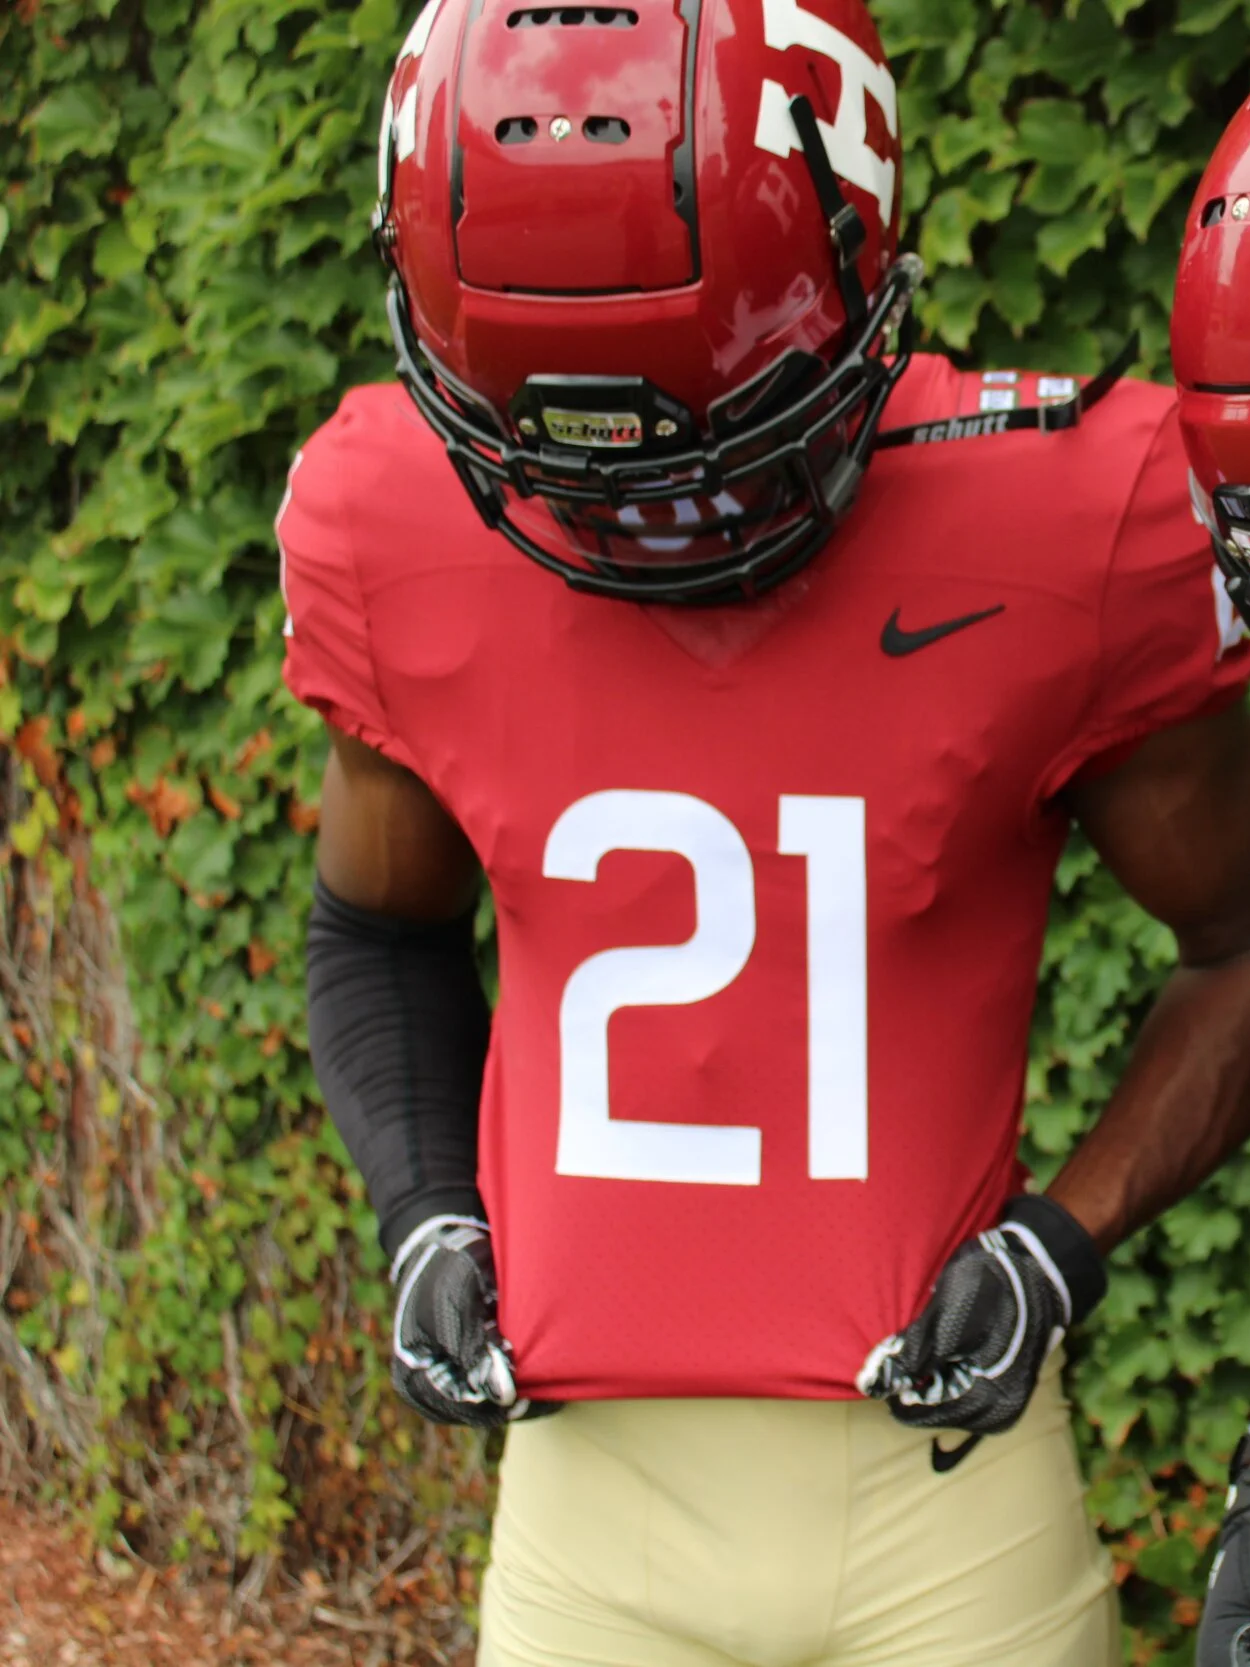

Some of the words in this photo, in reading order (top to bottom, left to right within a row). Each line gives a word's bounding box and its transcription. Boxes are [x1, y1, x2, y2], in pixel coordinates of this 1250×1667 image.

[754, 0, 898, 228] H
[551, 419, 641, 441] schutt
[913, 413, 1010, 444] schutt
[542, 788, 868, 1186] 21
